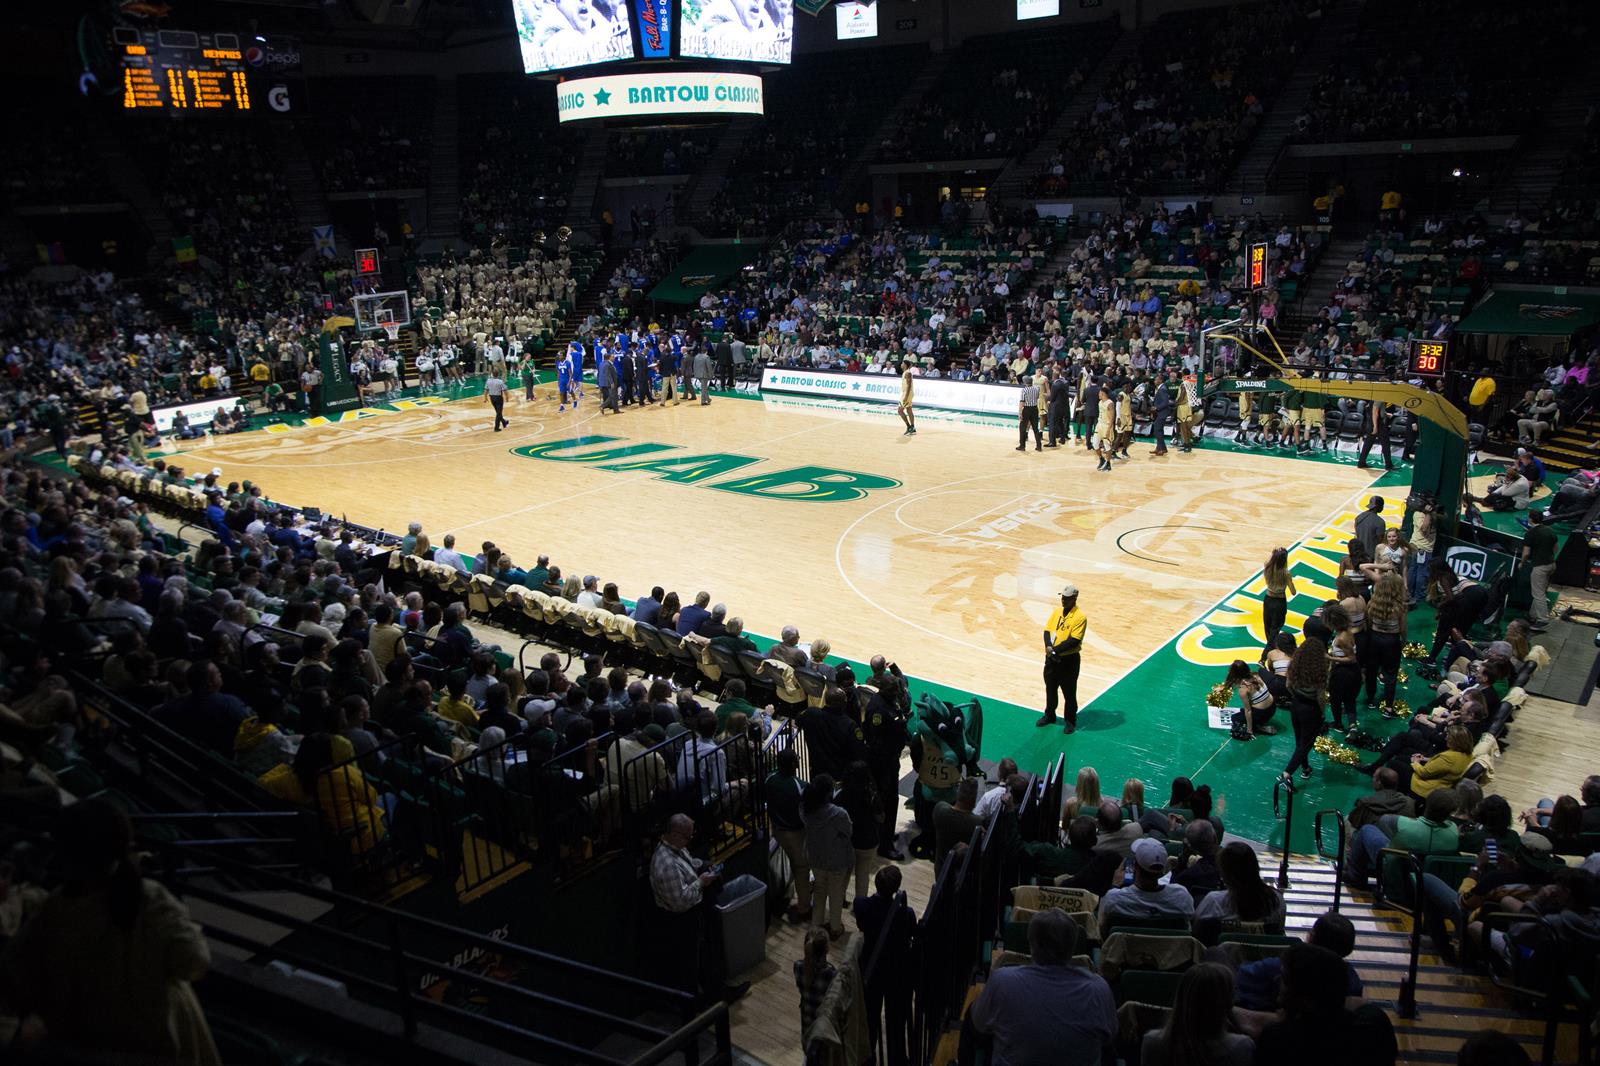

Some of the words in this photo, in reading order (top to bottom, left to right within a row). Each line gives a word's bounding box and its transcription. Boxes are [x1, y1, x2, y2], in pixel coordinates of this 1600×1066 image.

[266, 51, 300, 64] pepsi
[268, 85, 291, 112] G
[628, 85, 709, 104] BARTOW
[714, 85, 760, 103] CLASSIC
[1421, 344, 1443, 356] 3:32
[1418, 355, 1437, 369] 30
[780, 375, 814, 387] BARTOW
[815, 378, 847, 390] CLASSIC
[1235, 380, 1267, 389] SPALDING
[508, 434, 904, 502] UAB
[930, 765, 948, 780] 45
